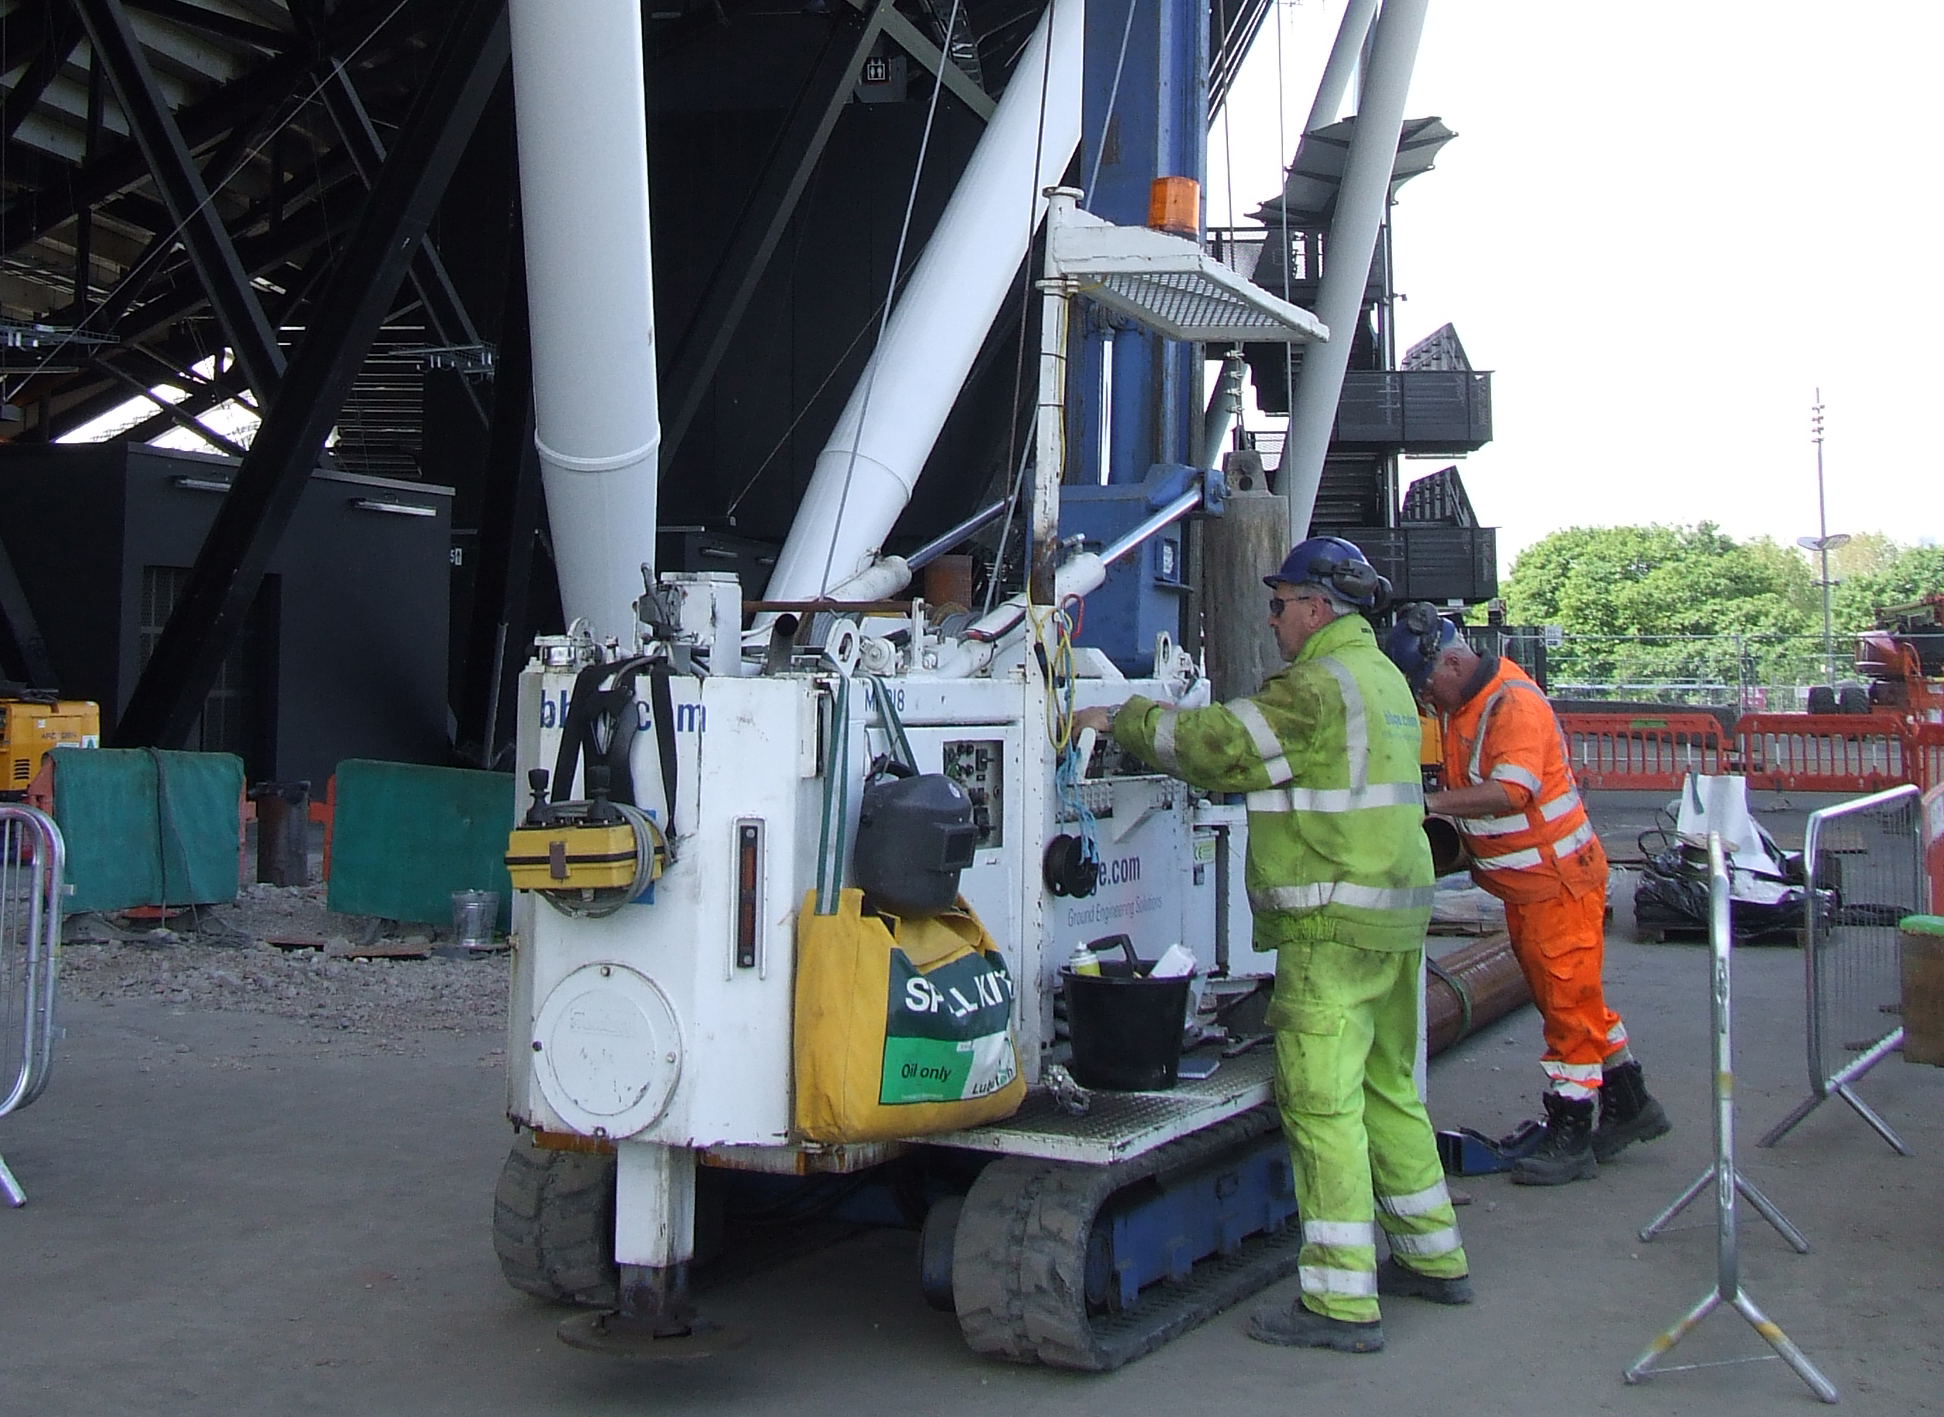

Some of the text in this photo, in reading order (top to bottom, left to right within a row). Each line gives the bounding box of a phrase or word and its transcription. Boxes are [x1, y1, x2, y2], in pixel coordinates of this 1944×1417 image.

[1068, 904, 1095, 927] Ground
[1096, 901, 1135, 925] Engineering
[906, 977, 979, 1018] SPL
[901, 1063, 952, 1082] Oil only
